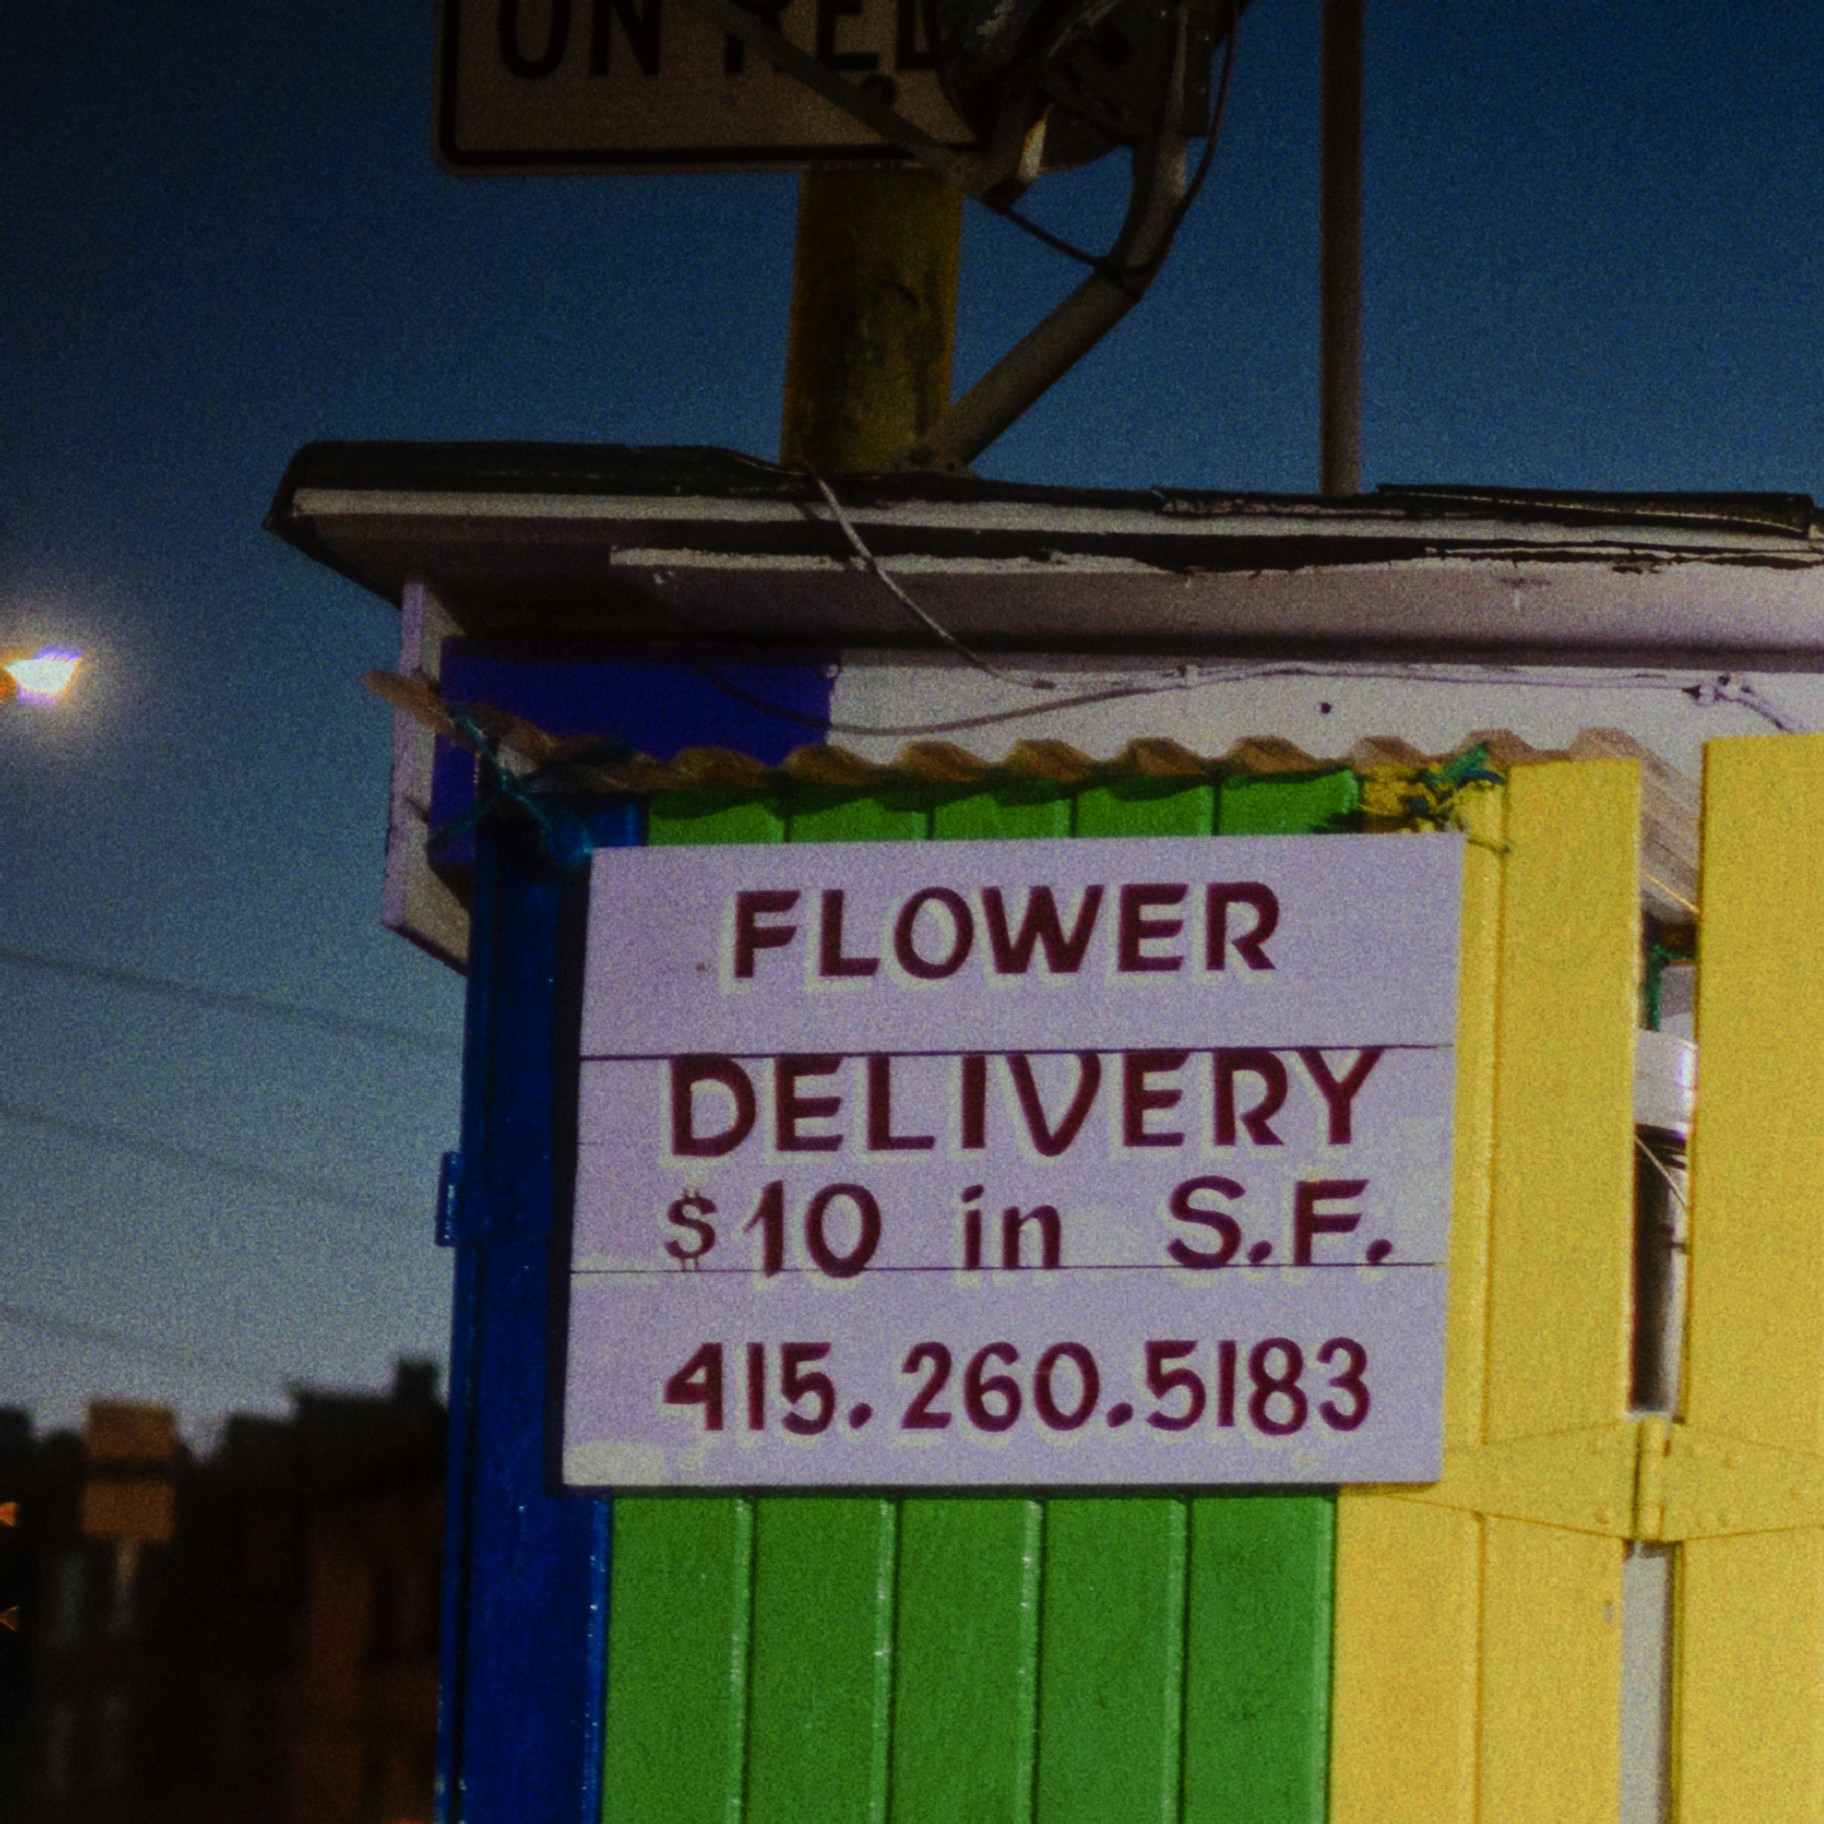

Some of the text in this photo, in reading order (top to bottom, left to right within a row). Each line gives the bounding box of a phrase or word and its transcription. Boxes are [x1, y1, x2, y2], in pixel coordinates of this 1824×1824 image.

[733, 881, 1281, 980] FLOWER
[667, 1044, 1388, 1158] DELIVERY
[664, 1175, 1394, 1278] $10 in S.F.
[664, 1337, 1371, 1436] 415.260.5183
